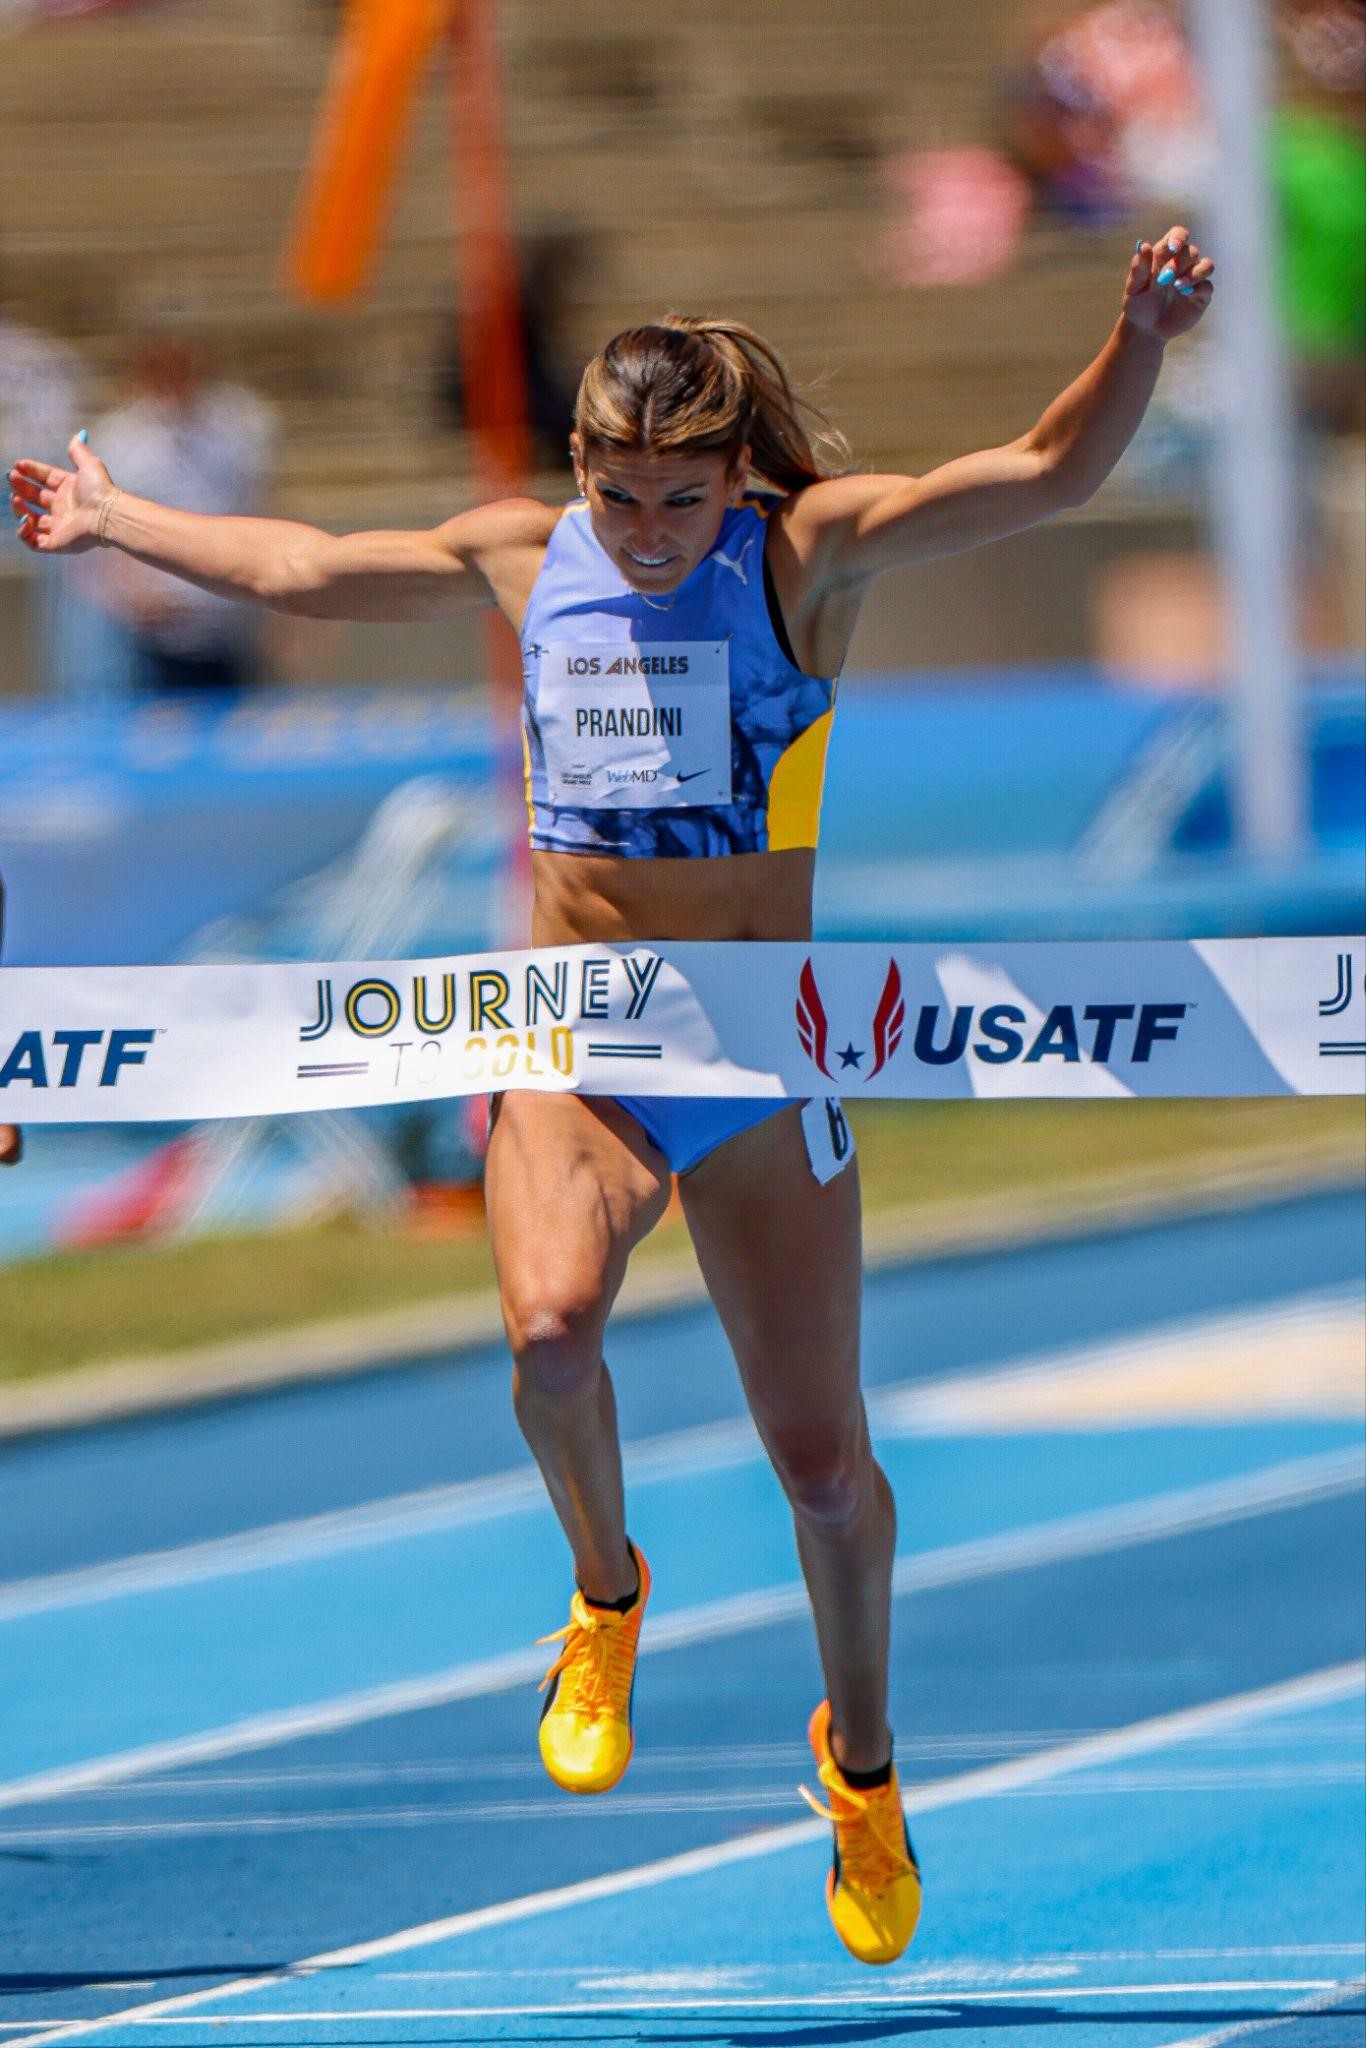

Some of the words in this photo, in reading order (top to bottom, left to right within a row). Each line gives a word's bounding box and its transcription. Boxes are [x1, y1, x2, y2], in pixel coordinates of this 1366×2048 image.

[567, 656, 601, 675] LOS
[605, 655, 689, 675] ANGELES
[576, 707, 682, 737] PRANDINI
[606, 769, 658, 784] WebMD
[298, 955, 665, 1042] JOURNEY
[388, 1040, 442, 1087] TO
